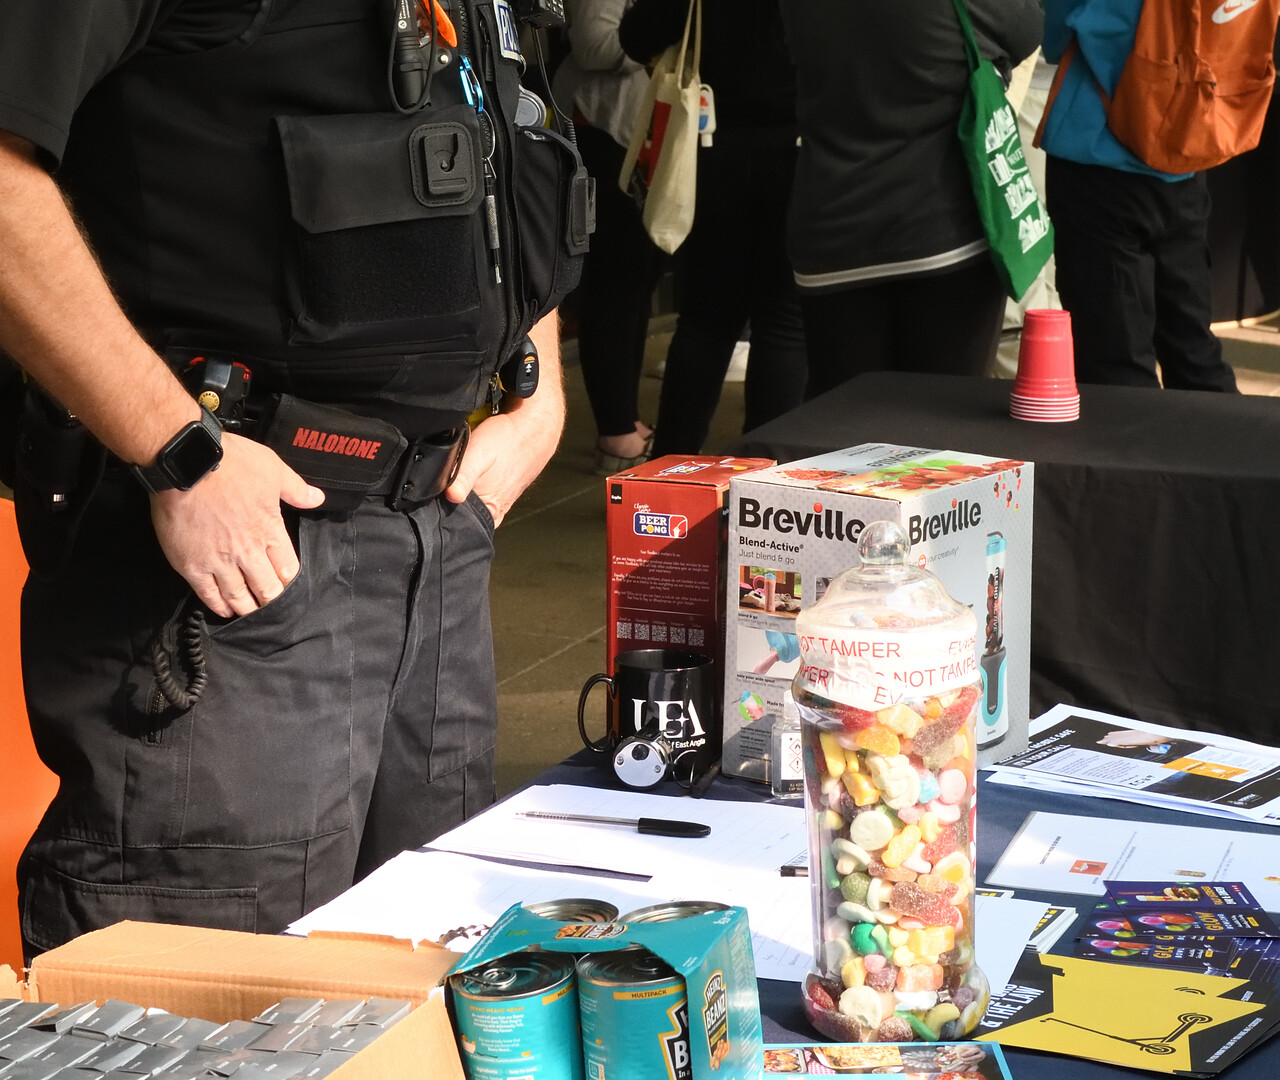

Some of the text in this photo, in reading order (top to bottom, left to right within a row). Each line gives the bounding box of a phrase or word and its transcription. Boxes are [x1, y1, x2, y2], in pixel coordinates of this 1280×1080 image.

[292, 427, 381, 460] NALOXONE
[639, 514, 668, 526] BEER
[641, 524, 667, 534] PONG
[739, 497, 866, 543] Breville
[909, 498, 981, 546] Breville
[739, 550, 754, 559] Just
[756, 551, 776, 562] blend
[784, 557, 795, 565] go
[818, 638, 900, 658] TAMPER
[632, 698, 706, 739] UEA
[676, 742, 689, 750] East
[1195, 912, 1224, 931] GLOW
[631, 989, 667, 999] MULTIPACK
[706, 976, 721, 1002] HEINZ
[1002, 986, 1044, 1004] LAW
[706, 994, 726, 1030] BEANZ
[986, 1002, 1023, 1020] THE
[980, 1015, 1003, 1028] &
